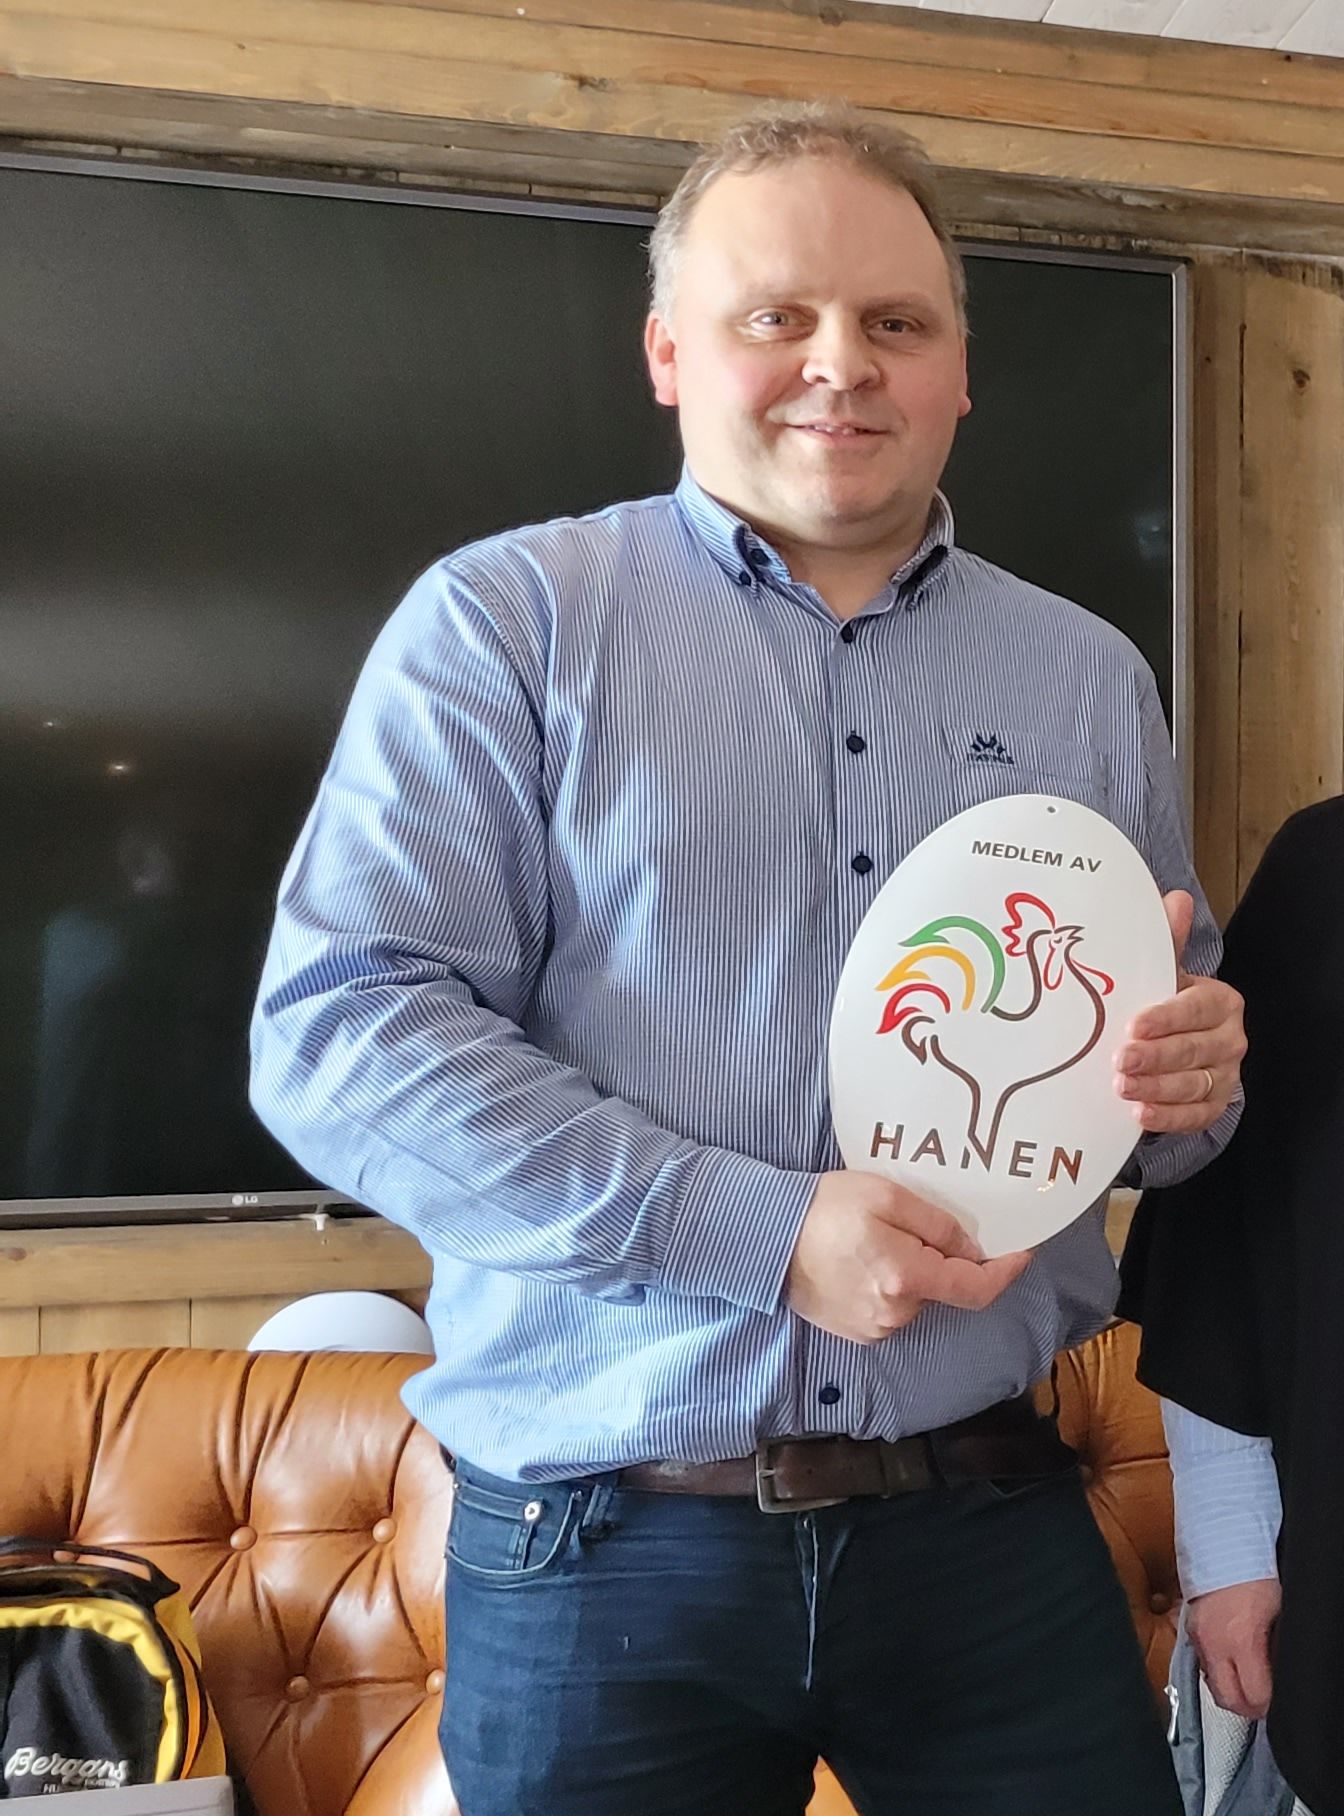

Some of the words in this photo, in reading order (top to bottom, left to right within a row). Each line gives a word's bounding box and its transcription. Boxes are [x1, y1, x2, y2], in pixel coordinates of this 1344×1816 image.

[971, 840, 1063, 868] MEDLEM
[1070, 855, 1103, 874] AV
[870, 1121, 1084, 1185] HANEN
[245, 1195, 258, 1204] LG
[4, 1746, 128, 1785] Bergans
